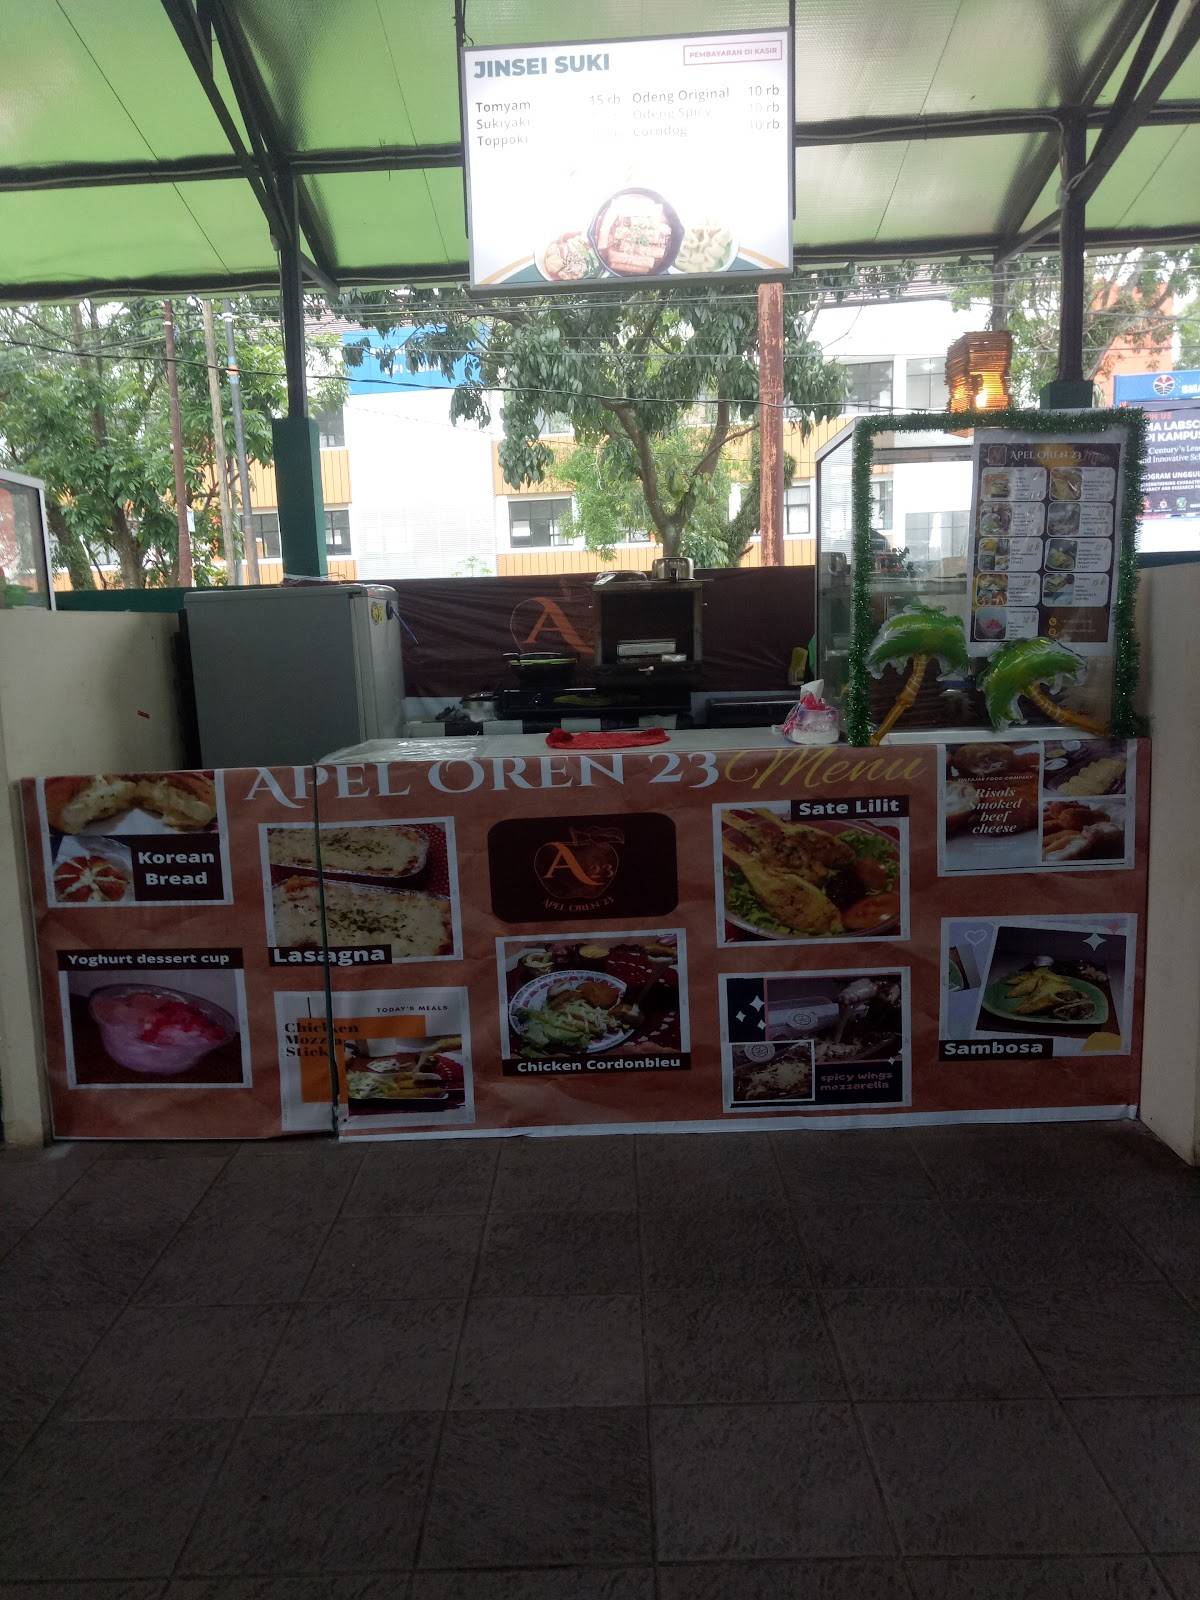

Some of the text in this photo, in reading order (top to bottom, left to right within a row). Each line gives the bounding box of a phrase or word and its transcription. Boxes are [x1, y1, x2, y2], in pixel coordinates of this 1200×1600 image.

[689, 50, 742, 59] PEMBAYARAN
[754, 47, 778, 56] KASIR
[474, 53, 610, 79] JINSEI SUKI
[632, 84, 780, 104] Odeng Original 10 rb
[475, 101, 531, 115] Tomyam
[766, 100, 780, 112] rb
[476, 117, 531, 130] Sukiyaki
[766, 118, 780, 130] rb
[476, 135, 528, 150] Toppoki
[1010, 450, 1034, 461] APEL
[1152, 453, 1189, 463] Innovative
[244, 746, 928, 809] APEL OREN 23 Menu
[975, 787, 1017, 799] Risols
[799, 799, 900, 816] Sate Lilit
[980, 811, 1013, 823] beef
[972, 823, 1017, 834] cheese
[138, 851, 215, 865] Korean
[589, 863, 614, 880] 23
[145, 871, 208, 886] Bread
[67, 952, 230, 967] Yoghurt dessert cup
[273, 947, 385, 966] Lasagna
[376, 1004, 449, 1014] TODAY'S MEALS
[285, 1022, 359, 1034] Chicken
[944, 1041, 1044, 1056] Sambosa
[516, 1057, 681, 1073] Chicken Cordonbleu
[820, 1071, 894, 1084] spicy wings
[819, 1081, 890, 1092] mozzarella
